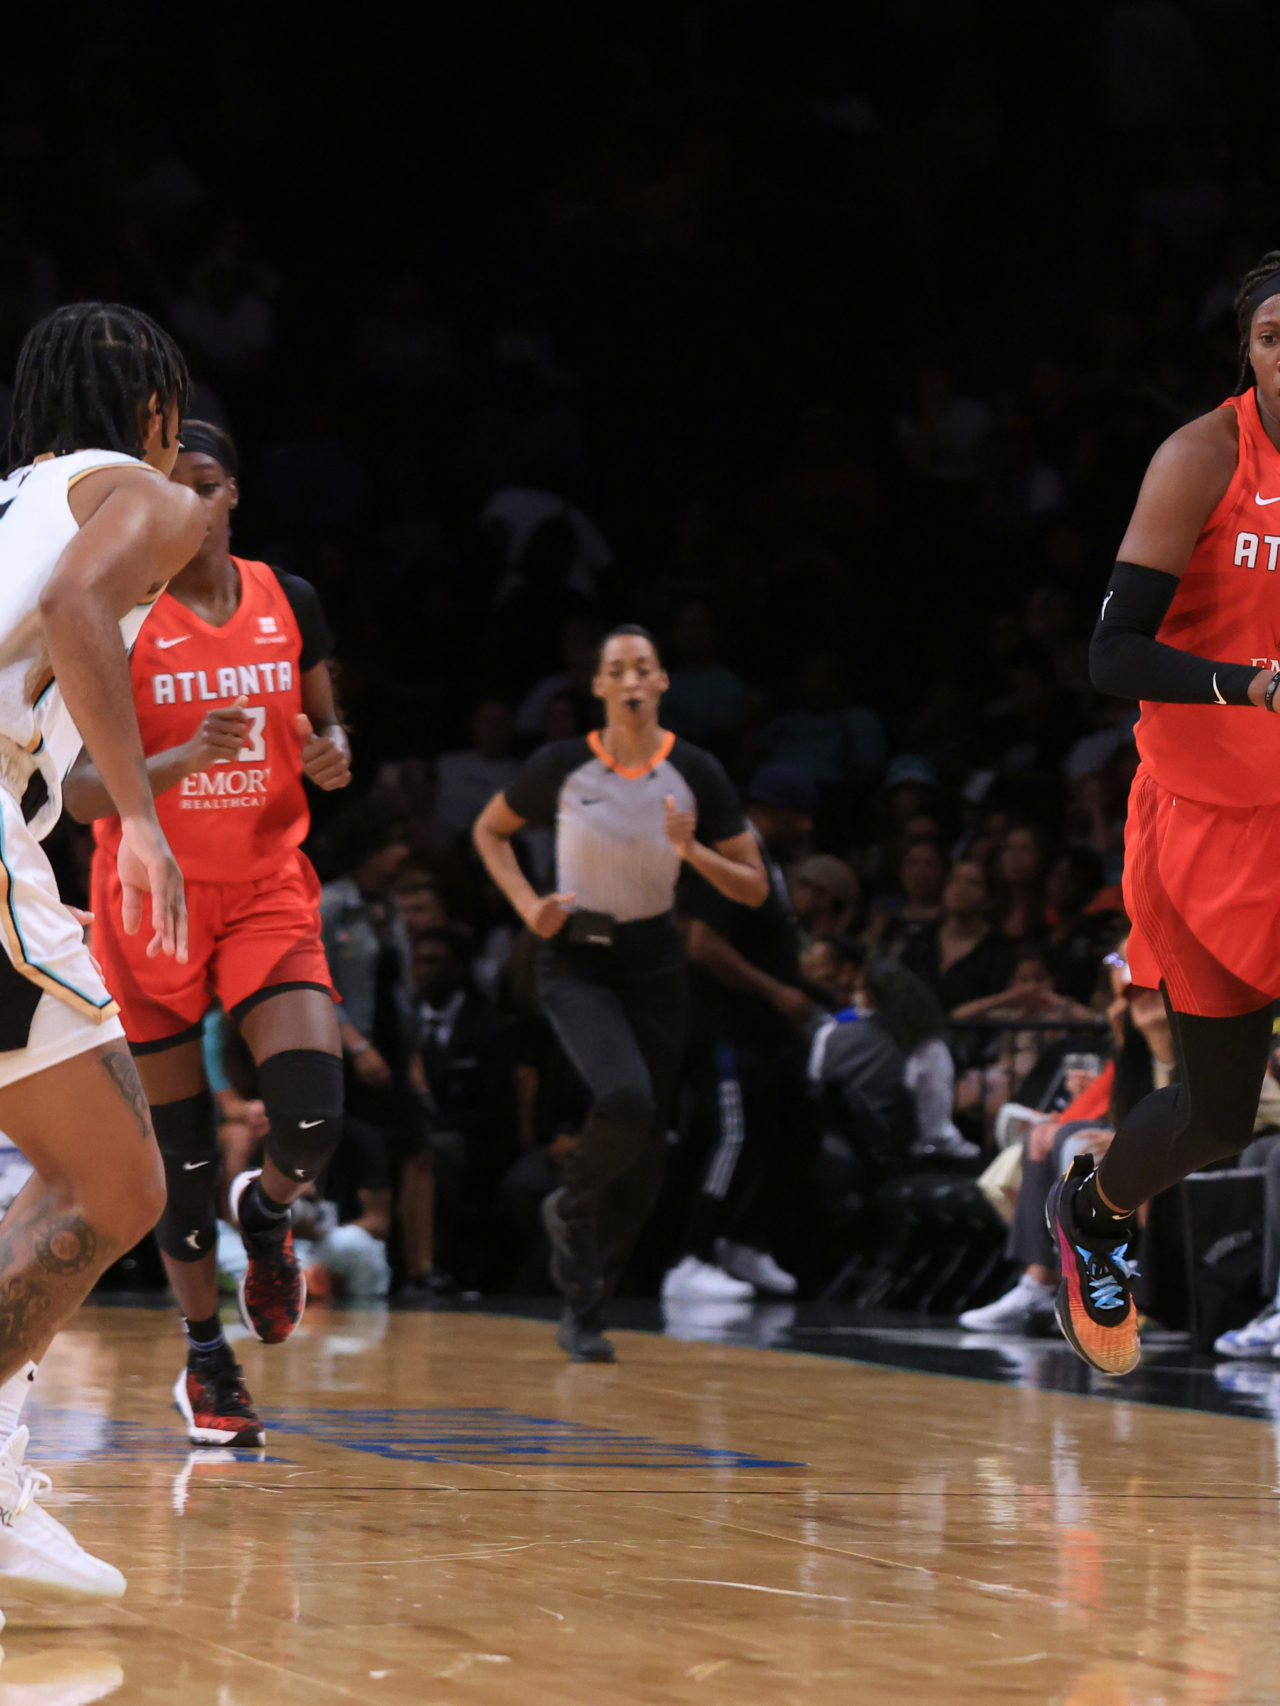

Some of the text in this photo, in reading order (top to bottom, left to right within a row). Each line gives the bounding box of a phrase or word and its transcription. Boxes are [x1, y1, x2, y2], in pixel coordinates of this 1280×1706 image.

[153, 661, 292, 704] ATLANTA
[213, 706, 266, 764] 3
[181, 768, 271, 796] EMOR
